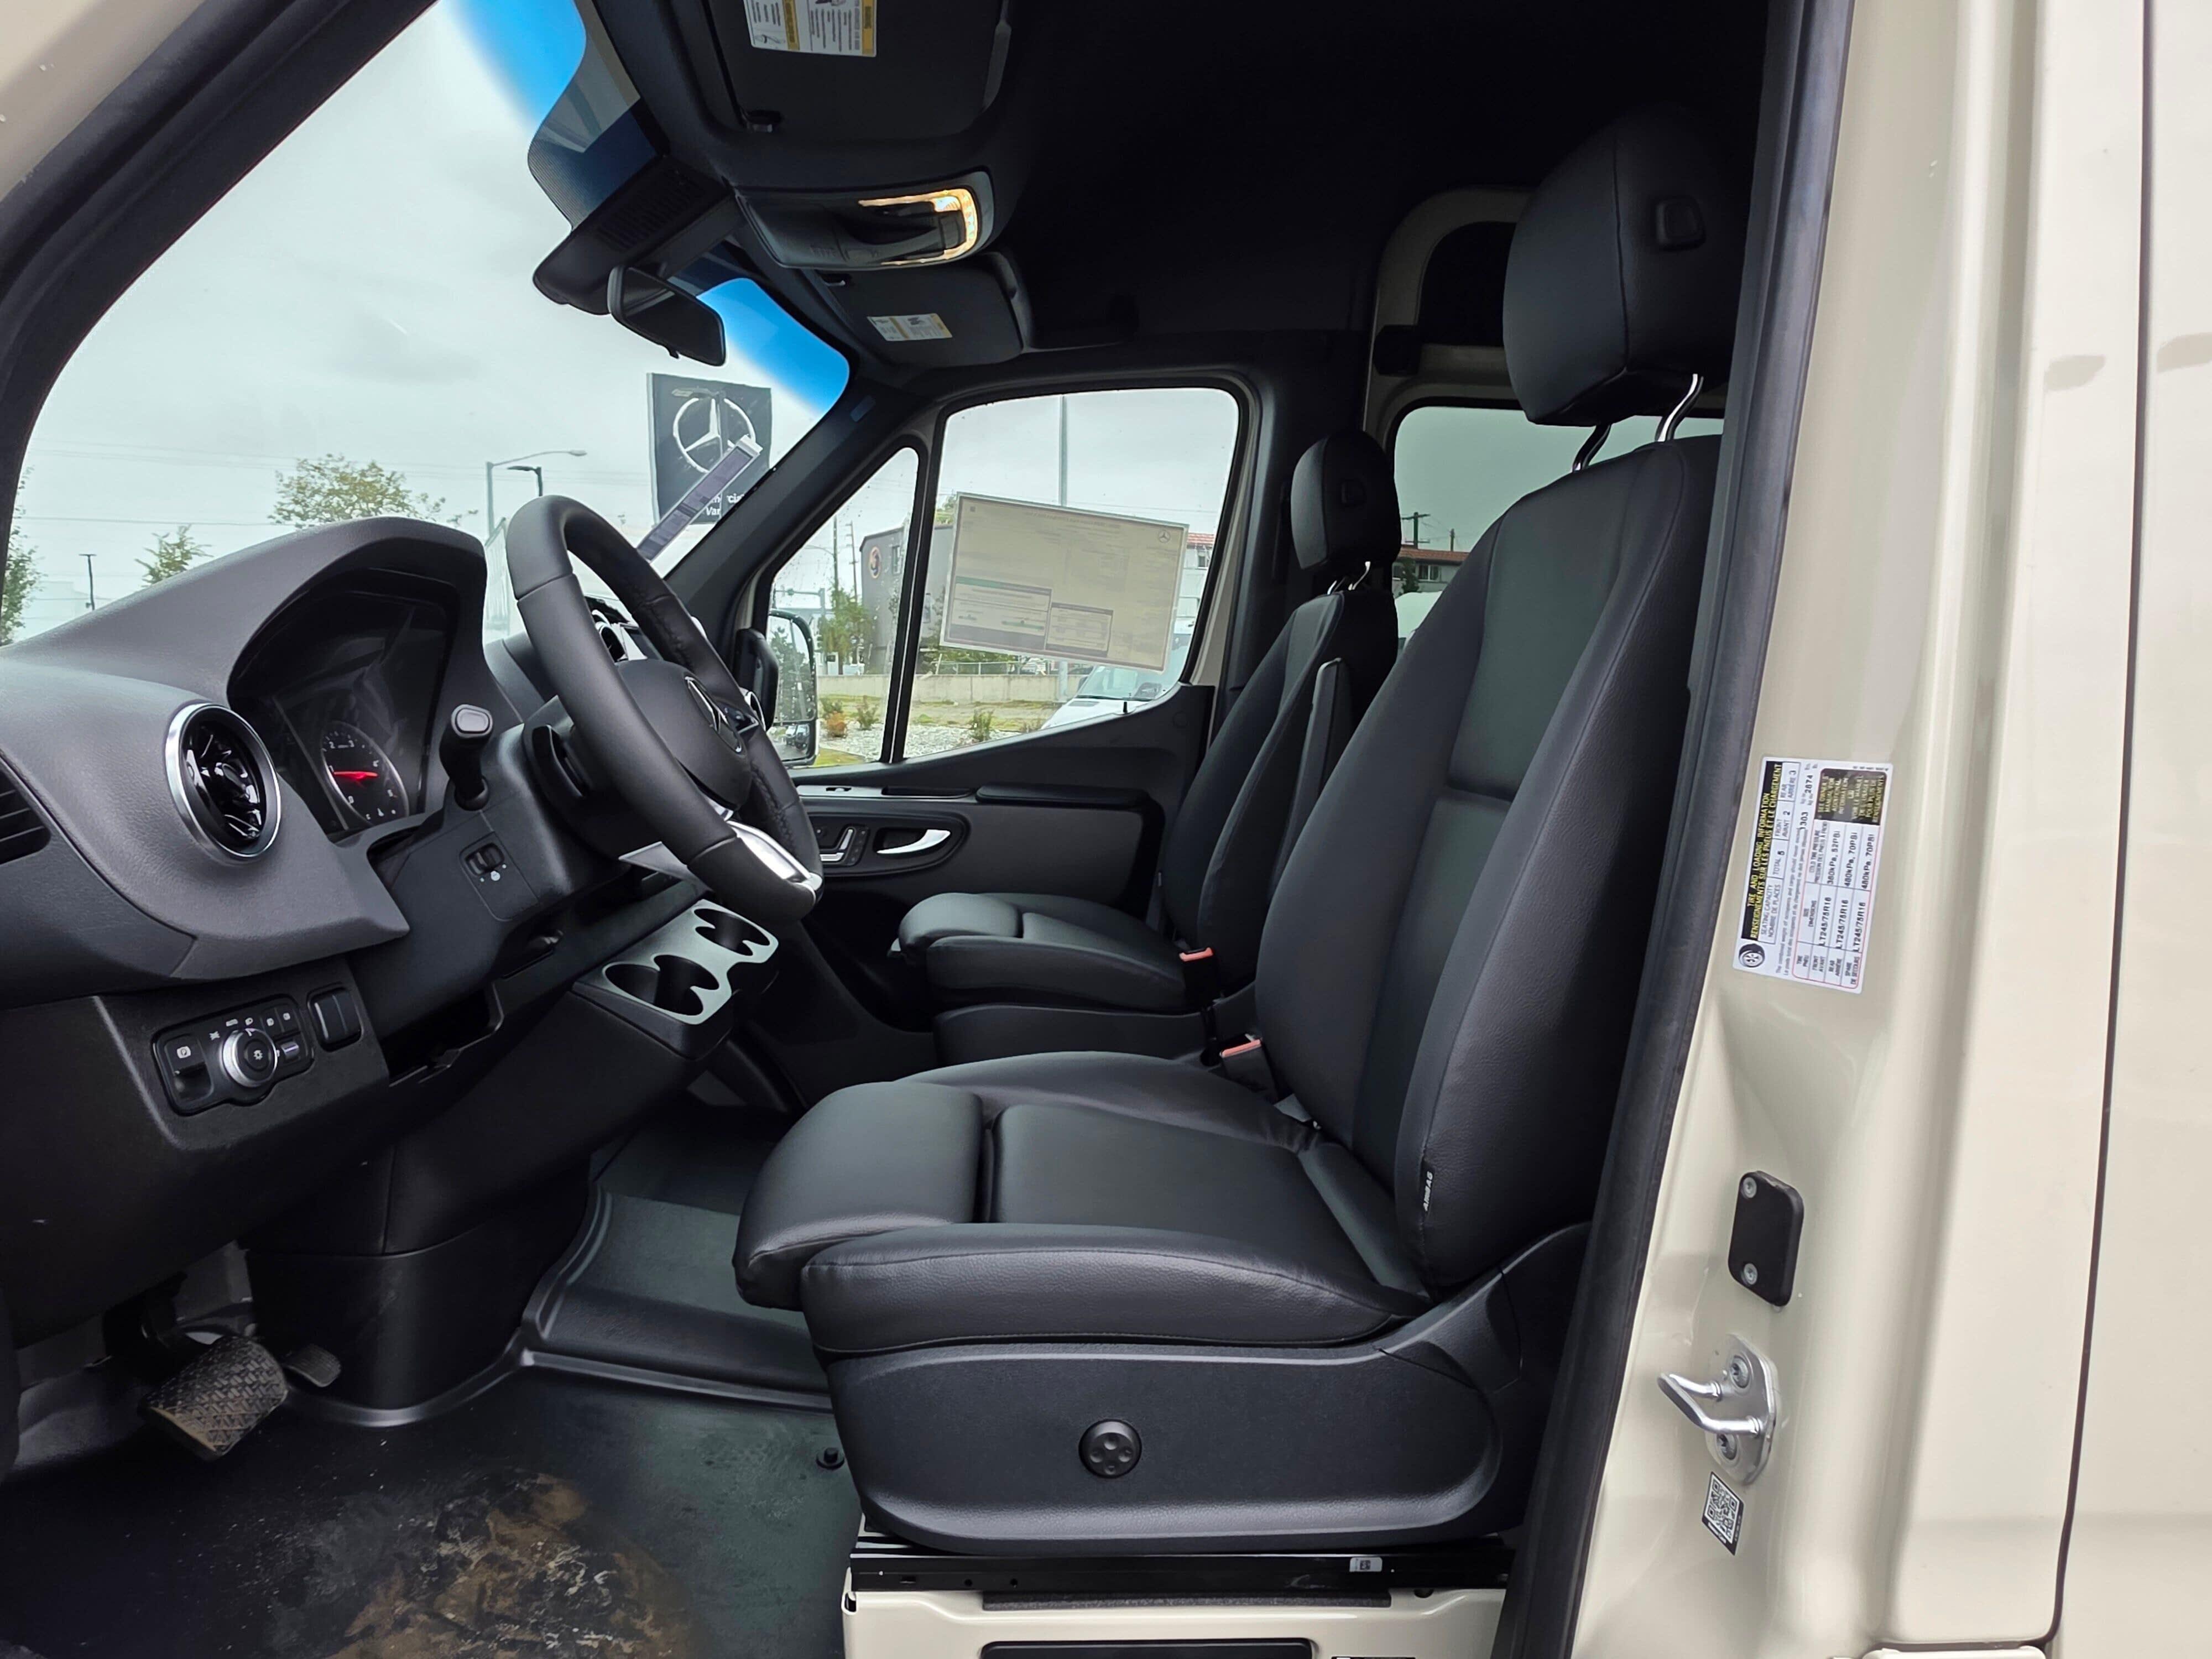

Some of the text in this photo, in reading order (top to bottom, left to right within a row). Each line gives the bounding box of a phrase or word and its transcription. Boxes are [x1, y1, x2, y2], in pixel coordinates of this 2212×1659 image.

[1804, 774, 1814, 793] 2874
[1774, 818, 1782, 837] FRONT
[1781, 819, 1790, 837] AVANT
[1798, 811, 1809, 830] 1303
[1746, 792, 1770, 907] TIRE AND LOADING INFORMATION
[1750, 763, 1782, 938] RENSEIGNEMENTS SUR LES PNEUS ET LE CHARGEMENT
[1848, 832, 1858, 854] 70PSI
[1865, 833, 1875, 857] 70PSI
[1772, 857, 1781, 875] TOTAL
[1760, 884, 1773, 935] SEATING CAPACITY
[1818, 896, 1832, 946] LT245/75R16
[1835, 899, 1849, 950] LT245/75R16
[1852, 901, 1866, 952] LT245/75R16
